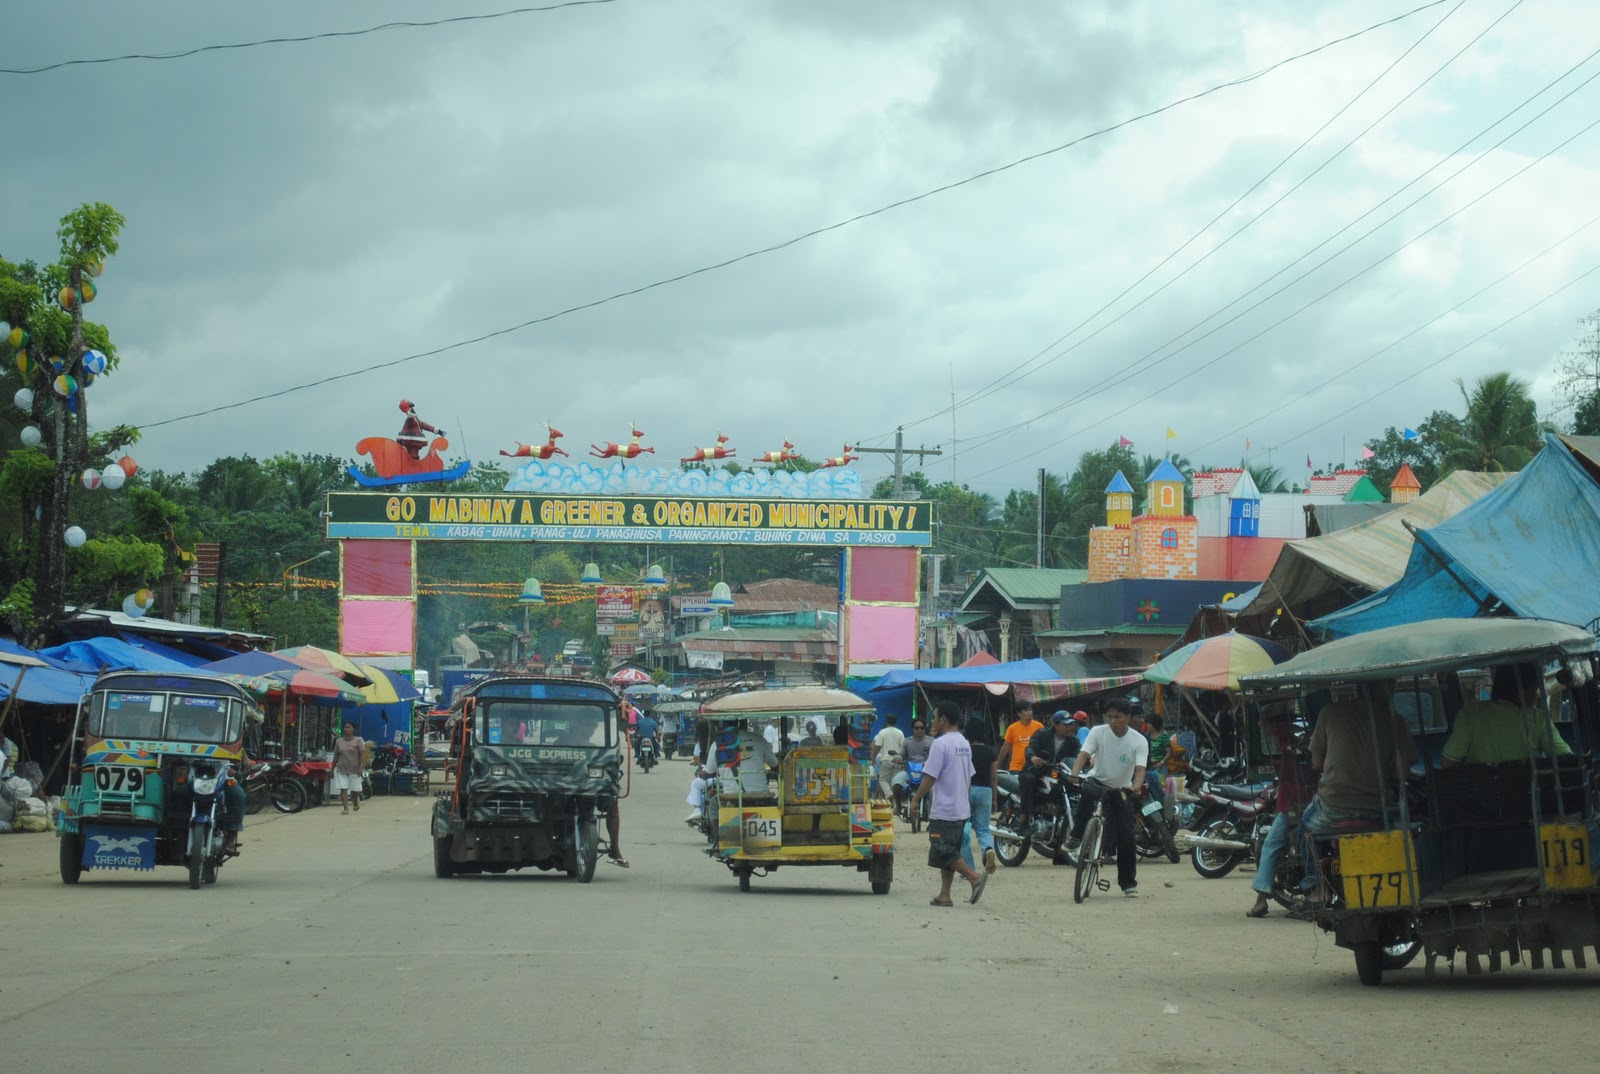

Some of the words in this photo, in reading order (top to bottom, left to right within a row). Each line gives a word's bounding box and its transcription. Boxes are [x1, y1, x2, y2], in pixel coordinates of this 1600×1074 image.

[386, 497, 416, 522] GO
[429, 497, 515, 524] MABINAY
[520, 499, 534, 525] A
[540, 499, 625, 526] GREENER
[631, 503, 649, 526] &
[653, 501, 764, 528] ORGANIZED
[395, 525, 436, 537] TEMA:
[447, 526, 527, 539] KABAG-UHAN:
[530, 528, 592, 539] PANAG-ULI
[596, 528, 662, 540] PANAGHIUSA
[668, 529, 750, 542] PANINGKAMOT:
[754, 530, 792, 542] BUHING
[796, 531, 827, 543] DIWA
[833, 532, 850, 543] SA
[858, 532, 897, 544] PASKO
[508, 749, 532, 759] JCG
[539, 749, 586, 760] EXPRESS
[96, 766, 143, 792] 079
[748, 820, 777, 837] 045
[94, 855, 142, 866] TREKKER
[1355, 872, 1401, 907] 179
